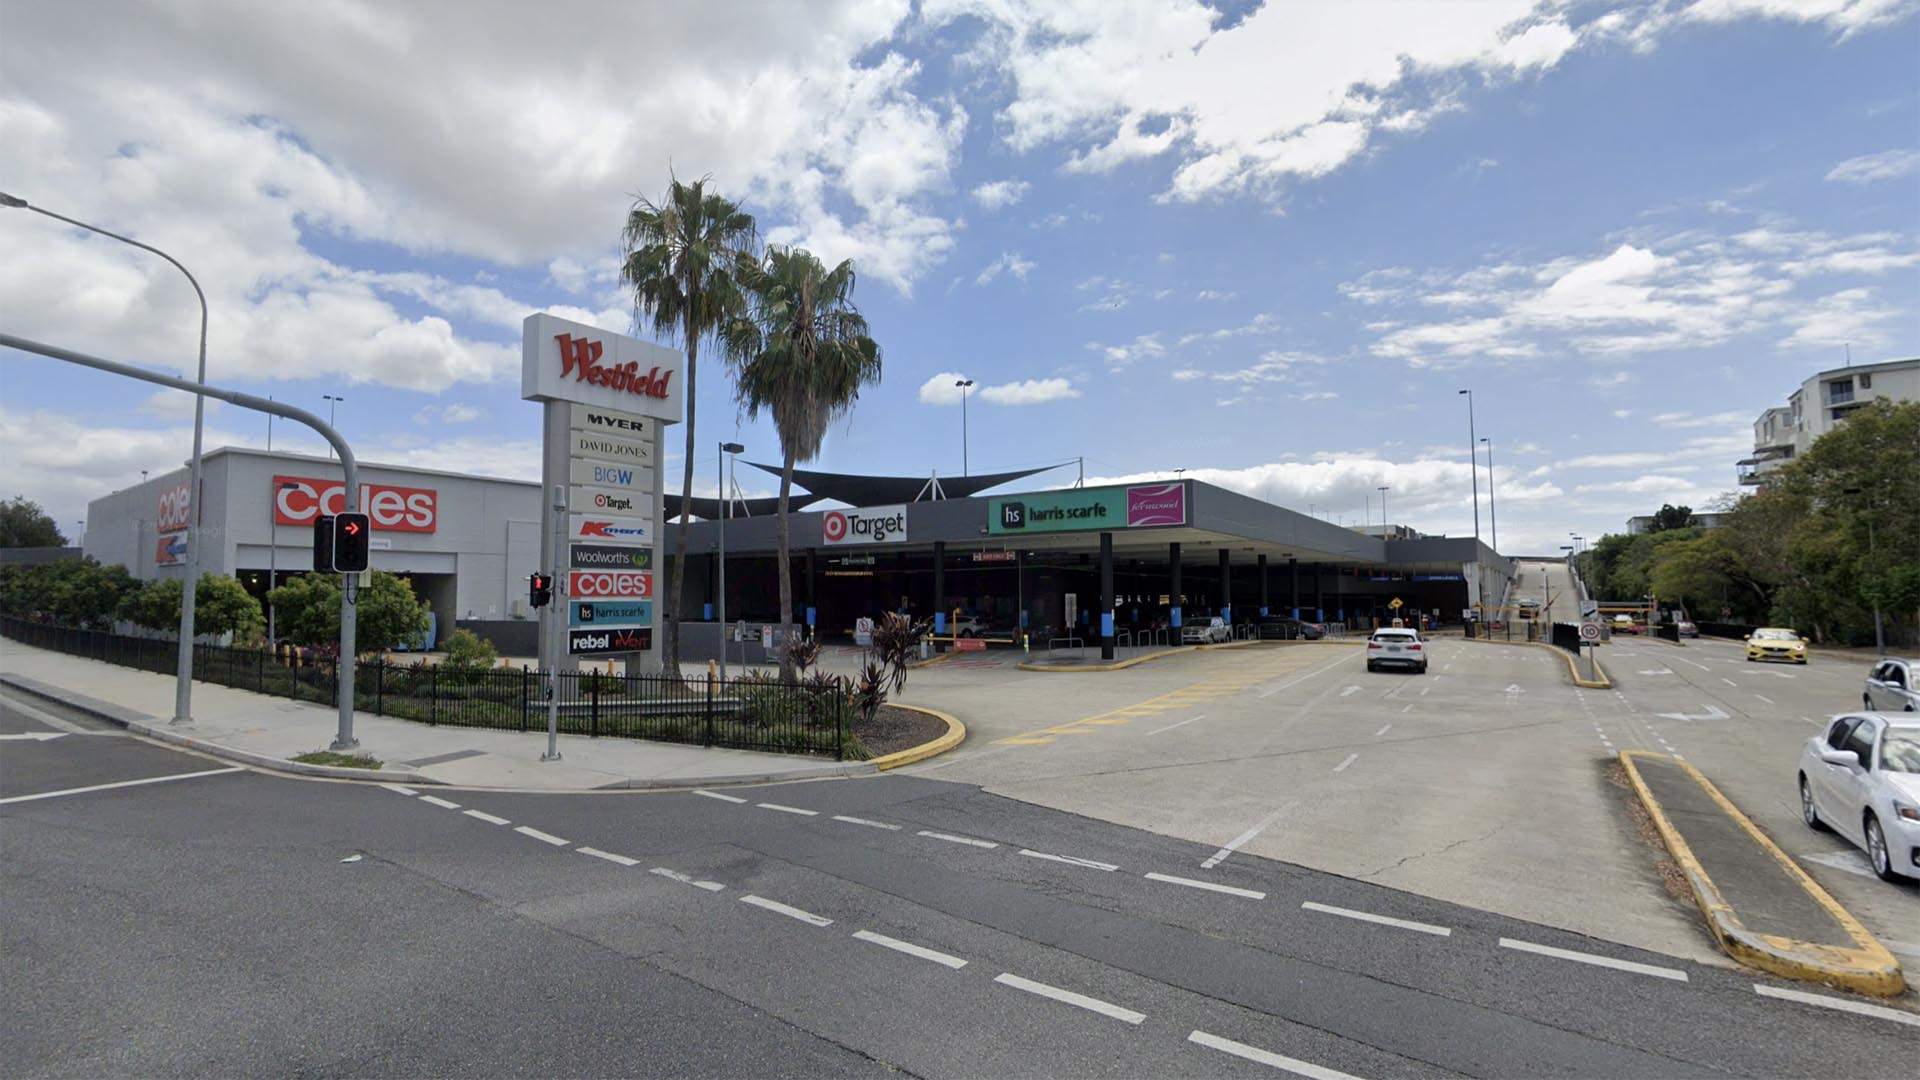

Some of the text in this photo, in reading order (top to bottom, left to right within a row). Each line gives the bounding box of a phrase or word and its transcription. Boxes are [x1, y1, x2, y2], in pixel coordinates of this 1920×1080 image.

[554, 333, 674, 399] Westfield
[587, 413, 643, 431] MYER
[580, 439, 647, 457] DAVID JONES
[158, 486, 192, 528] cole
[1005, 502, 1106, 523] hs harris scarfe
[580, 520, 645, 537] Kmart
[848, 512, 904, 541] Target
[576, 551, 630, 565] Woolworths
[577, 573, 646, 595] coles
[581, 606, 646, 618] hs harris scarfe
[1585, 627, 1596, 636] 10
[572, 634, 610, 650] rebel
